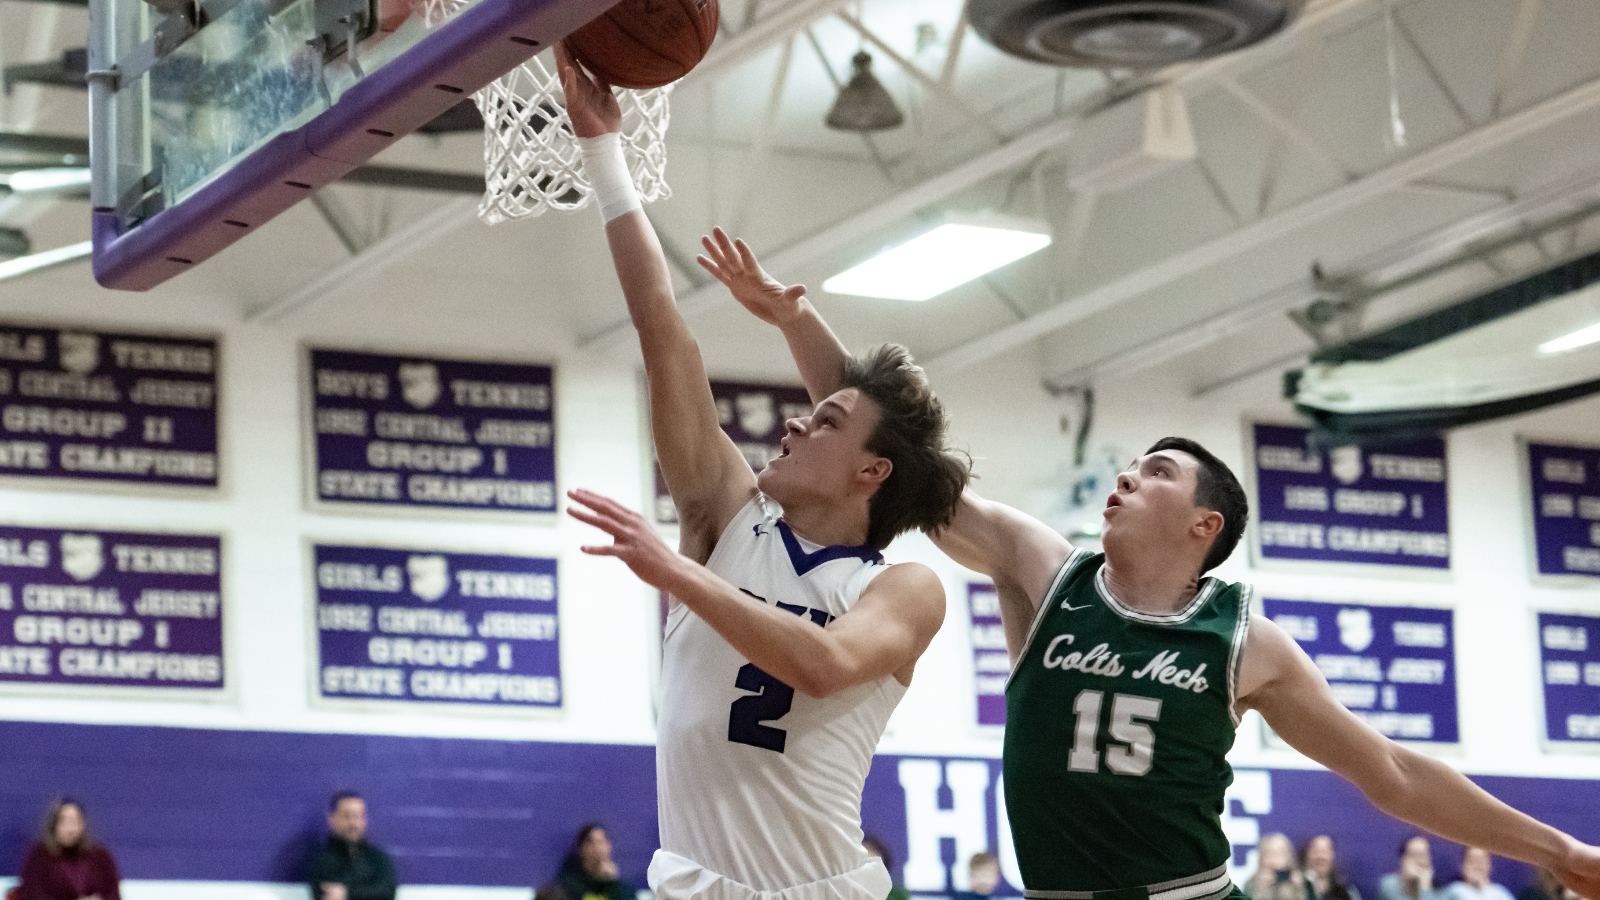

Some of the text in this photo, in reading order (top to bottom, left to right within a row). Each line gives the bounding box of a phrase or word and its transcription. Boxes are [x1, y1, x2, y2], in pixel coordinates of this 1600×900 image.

[111, 340, 213, 373] TENNIS
[19, 370, 120, 402] CENTRAL
[130, 378, 212, 408] JERSEY
[317, 368, 549, 410] BOYS TENNIS
[3, 404, 172, 443] GROUP II
[375, 411, 468, 443] CENTRAL
[475, 418, 551, 448] JERSEY
[60, 443, 216, 479] CHAMPIONS
[367, 440, 482, 473] GROUP
[319, 469, 555, 507] STATE CHAMPIONS
[112, 544, 216, 575] TENNIS
[318, 562, 554, 600] GIRLS TENNIS
[22, 583, 125, 615] CENTRAL
[134, 588, 218, 618] JERSEY
[14, 615, 143, 647] GROUP
[377, 606, 471, 637] CENTRAL
[477, 610, 556, 640] JERSEY
[60, 647, 220, 682] CHAMPIONS
[368, 636, 487, 668] GROUP
[1043, 634, 1125, 677] Colts
[1132, 650, 1209, 693] Neck
[322, 665, 558, 703] STATE CHAMPIONS
[728, 662, 794, 754] 2
[1067, 688, 1163, 776] 15
[898, 758, 1272, 894] HE
